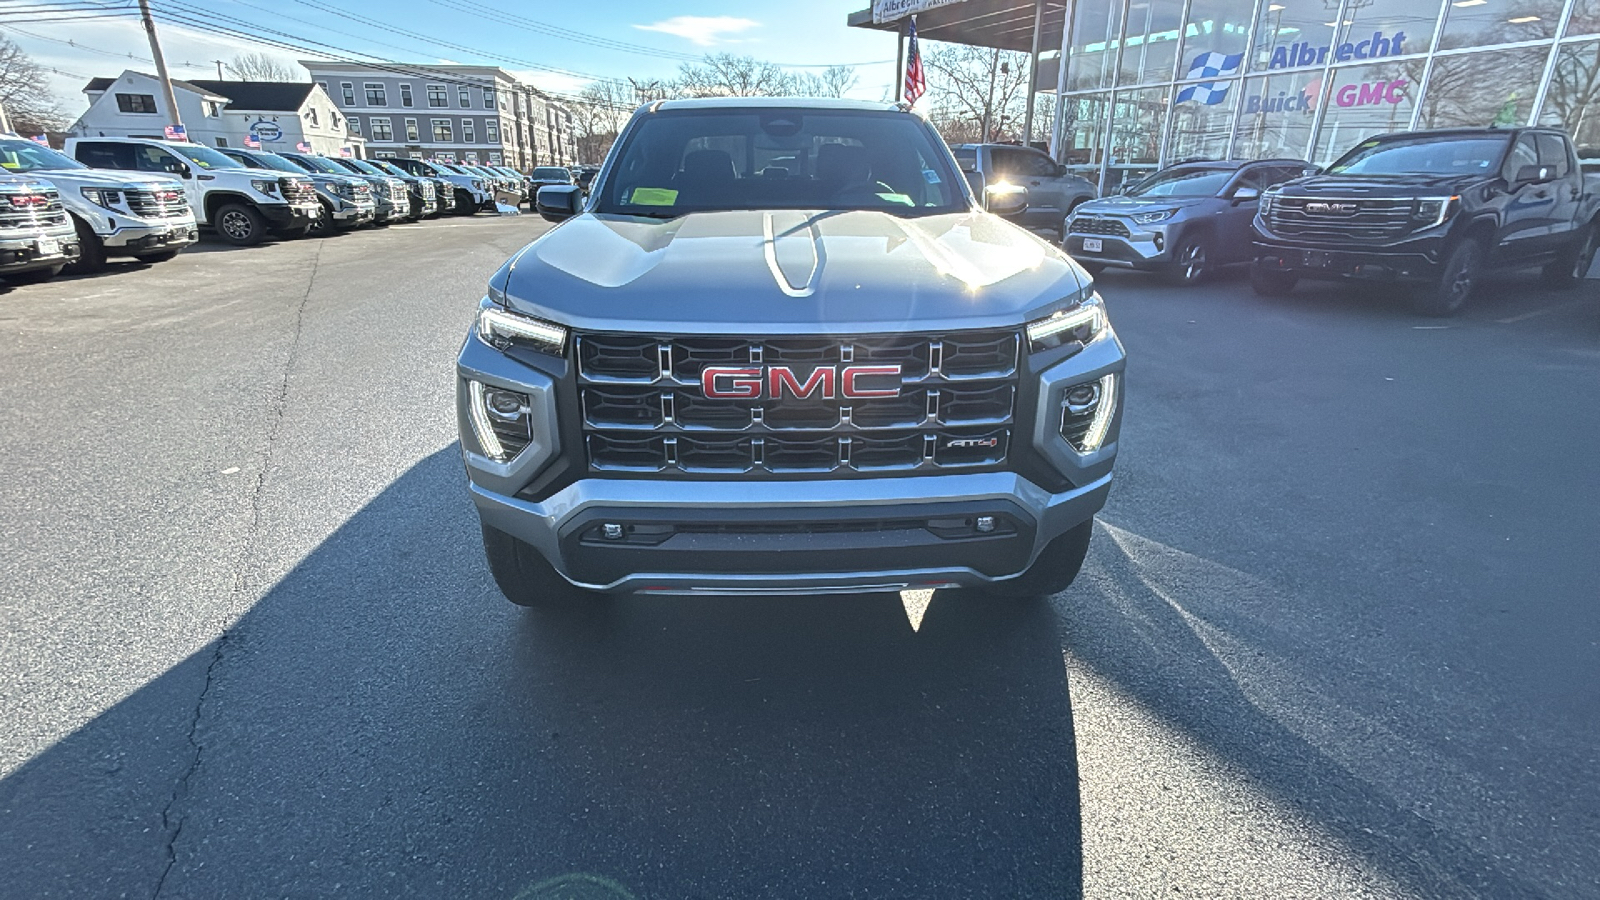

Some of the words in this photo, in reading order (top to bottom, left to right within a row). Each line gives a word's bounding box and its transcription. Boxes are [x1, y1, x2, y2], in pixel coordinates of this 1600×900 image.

[1269, 31, 1406, 69] Albrecht
[1245, 92, 1312, 114] Buick
[1336, 79, 1406, 107] GMC
[1306, 203, 1357, 213] GMC
[702, 365, 901, 399] GMC
[947, 437, 997, 447] AT4
